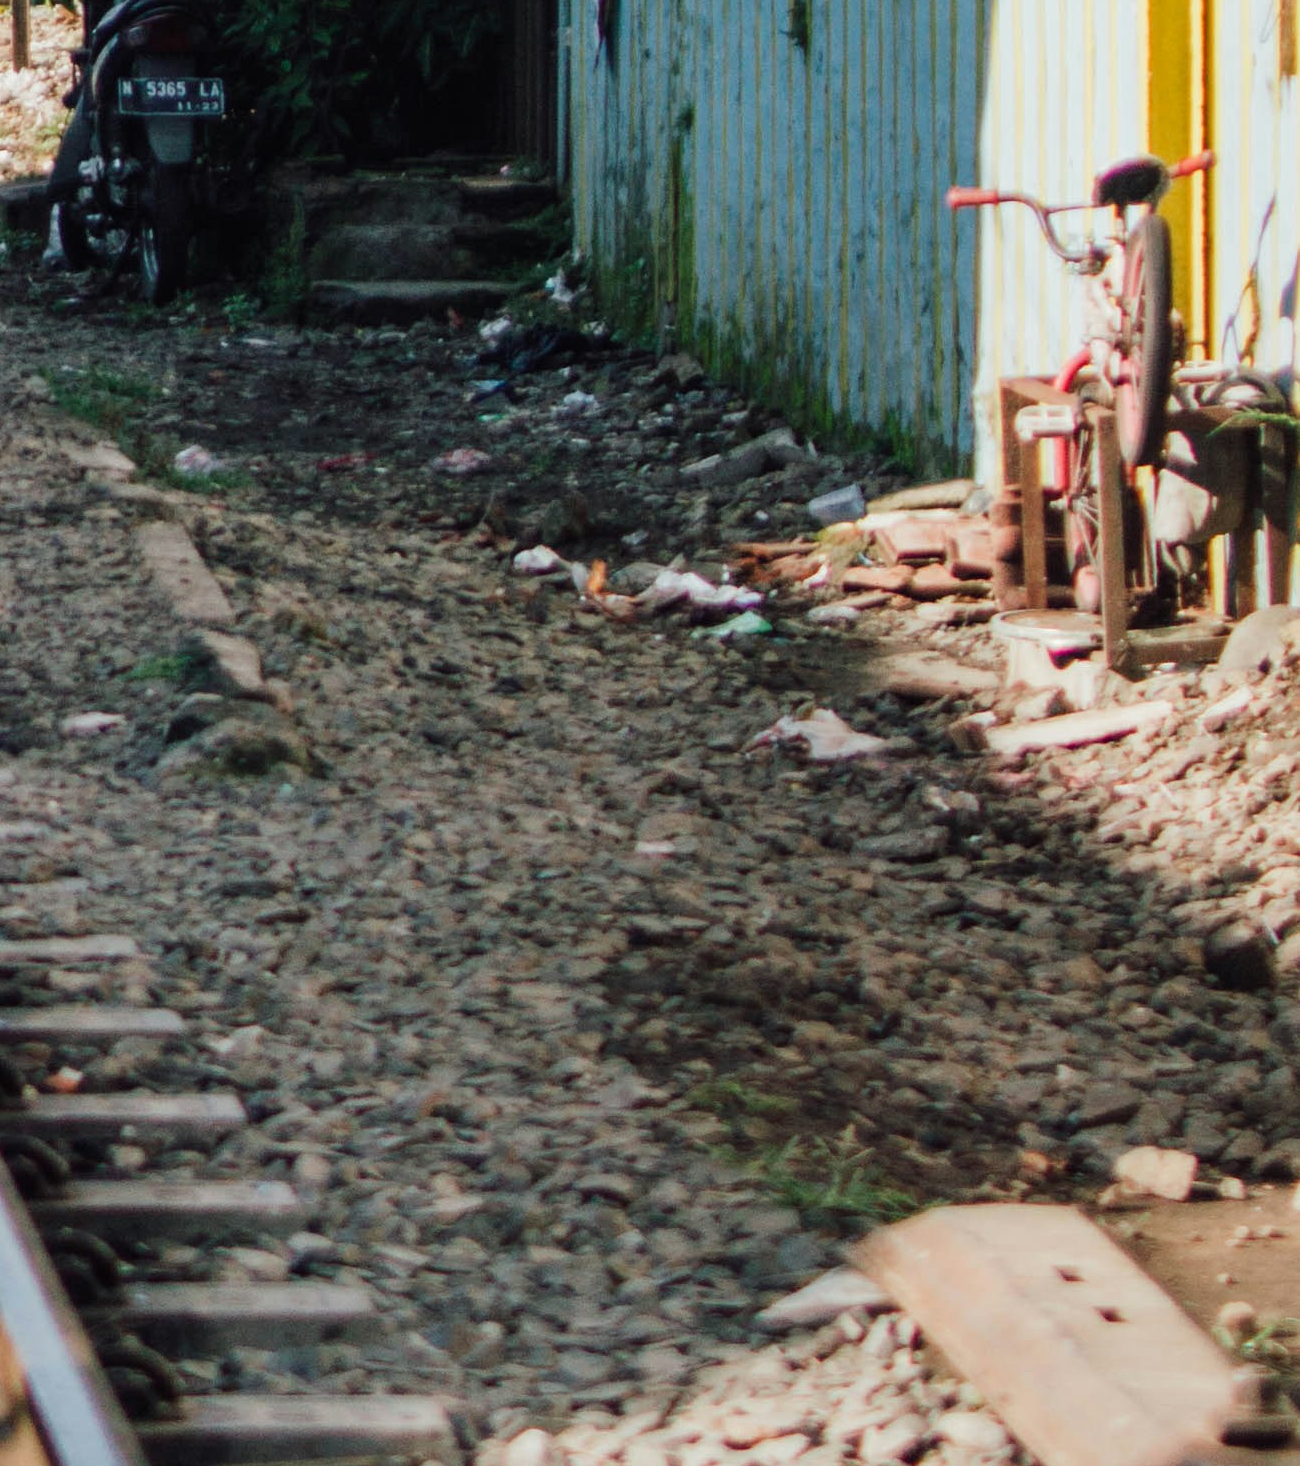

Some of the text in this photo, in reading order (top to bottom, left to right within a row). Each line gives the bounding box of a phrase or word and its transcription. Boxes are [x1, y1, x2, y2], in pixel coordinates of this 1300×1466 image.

[122, 81, 220, 97] N 5365 LA
